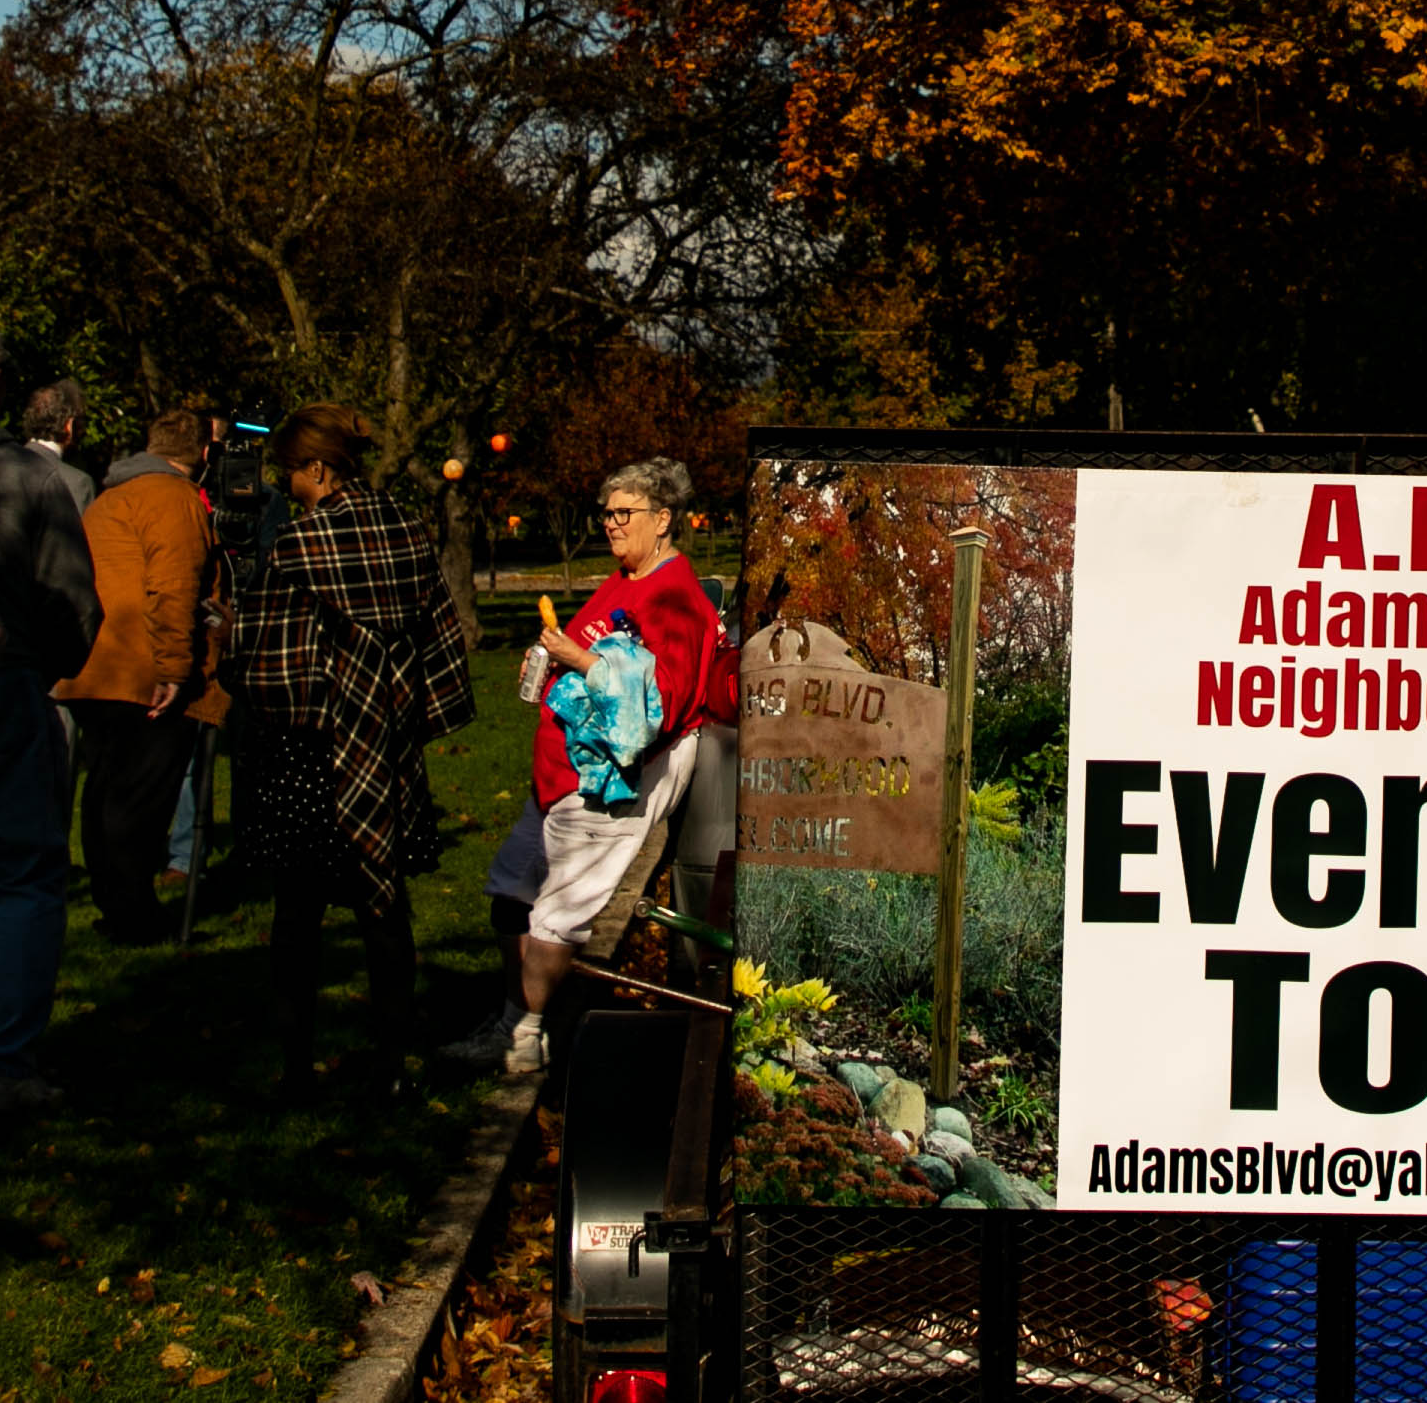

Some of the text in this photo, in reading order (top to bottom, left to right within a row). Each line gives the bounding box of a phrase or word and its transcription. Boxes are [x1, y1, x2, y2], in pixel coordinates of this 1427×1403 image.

[741, 678, 894, 729] MS BLVD.
[611, 1225, 644, 1236] TRAC
